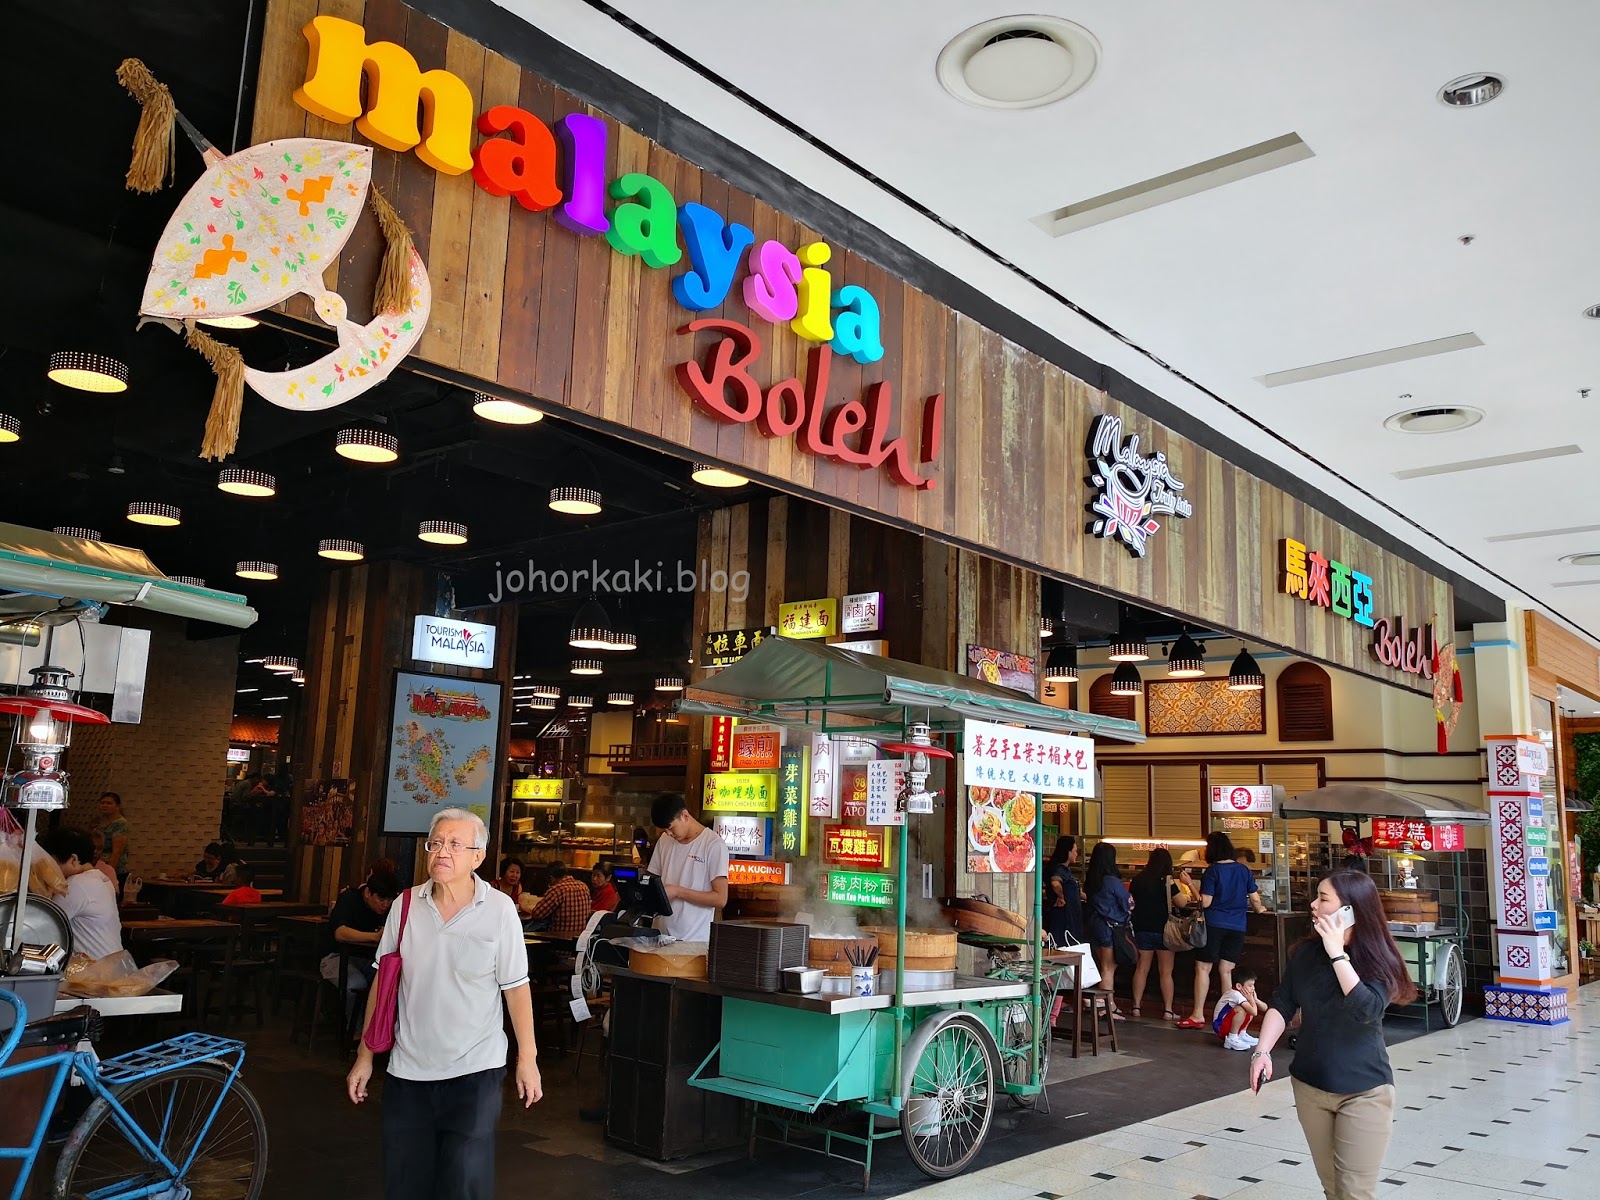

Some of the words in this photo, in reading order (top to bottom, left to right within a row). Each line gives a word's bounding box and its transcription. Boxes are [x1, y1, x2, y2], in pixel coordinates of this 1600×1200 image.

[294, 15, 884, 363] malaysia
[676, 319, 943, 490] Boleh!
[1092, 413, 1184, 491] Malaysia
[1151, 480, 1177, 509] Truly
[1176, 496, 1192, 518] Asia
[1281, 537, 1374, 628] 馬來西亞
[783, 609, 829, 630] 福建面
[426, 624, 462, 638] TOURISM
[431, 636, 485, 657] MALAYSIA
[1374, 617, 1434, 680] Boleh!
[738, 734, 774, 758] 蠔煎
[811, 733, 830, 812] 肉骨茶
[855, 777, 866, 788] 98
[705, 777, 717, 806] 姐妹
[1230, 788, 1271, 809] 發糕
[782, 763, 799, 850] 芽菜雞粉
[844, 806, 866, 817] APO
[1386, 821, 1427, 841] 發糕
[829, 837, 879, 856] 瓦煲雞飯
[729, 864, 746, 872] ATA
[748, 865, 782, 874] KUCING
[832, 874, 895, 894] 豬肉粉面
[871, 894, 894, 905] Noodles
